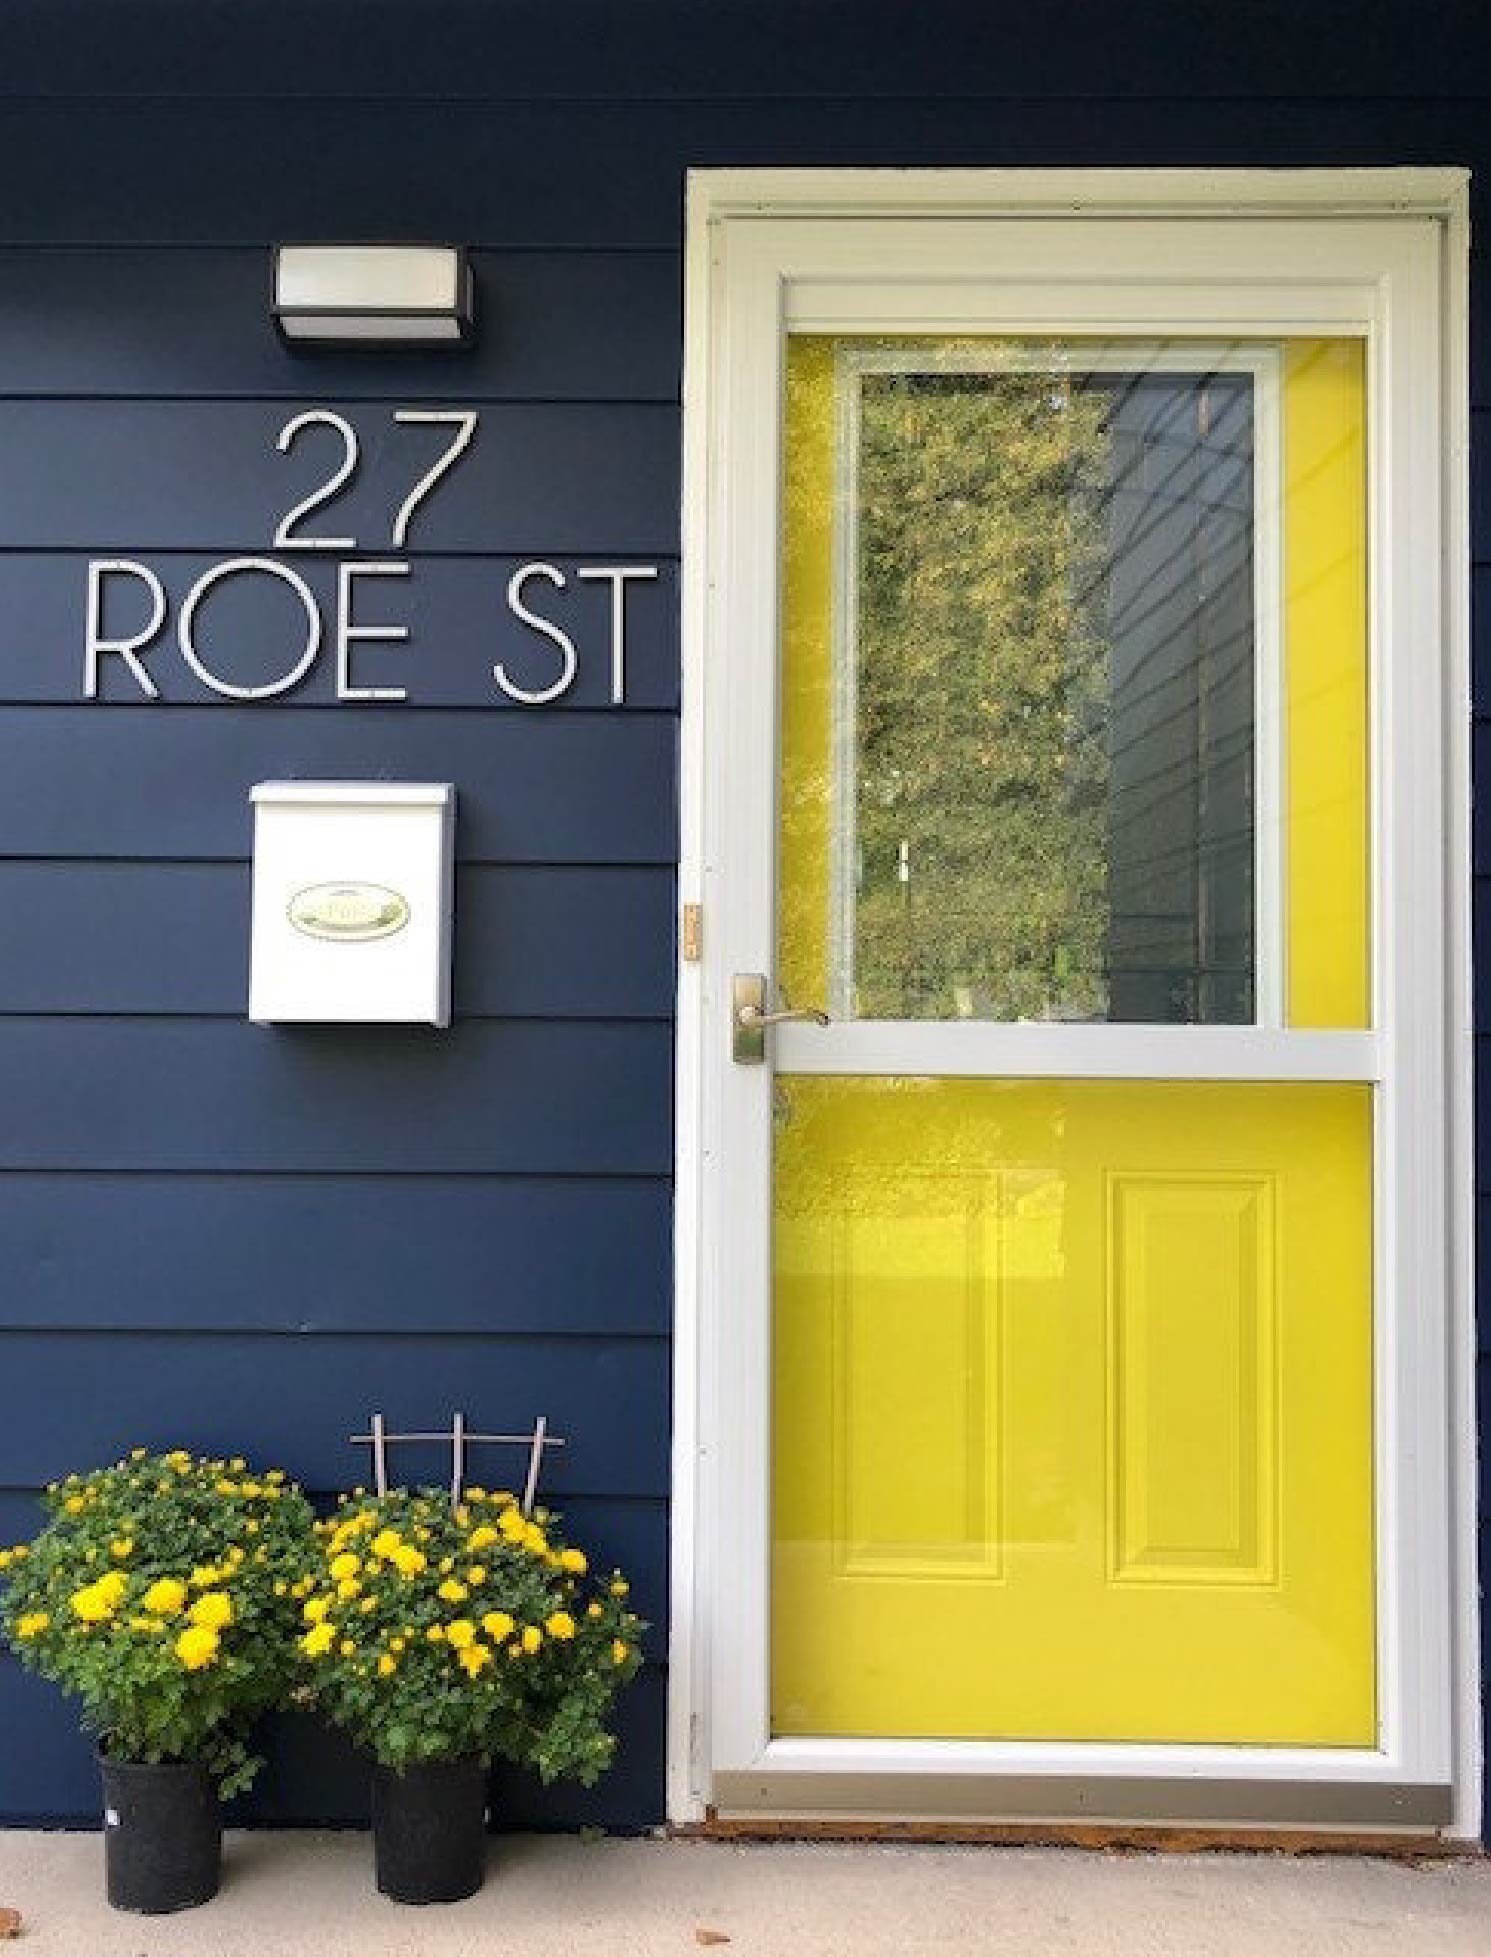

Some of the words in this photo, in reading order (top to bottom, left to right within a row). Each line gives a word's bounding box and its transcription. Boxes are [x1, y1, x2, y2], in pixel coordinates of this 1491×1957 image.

[273, 411, 477, 548] 27
[83, 558, 409, 699] ROE
[493, 562, 658, 704] ST
